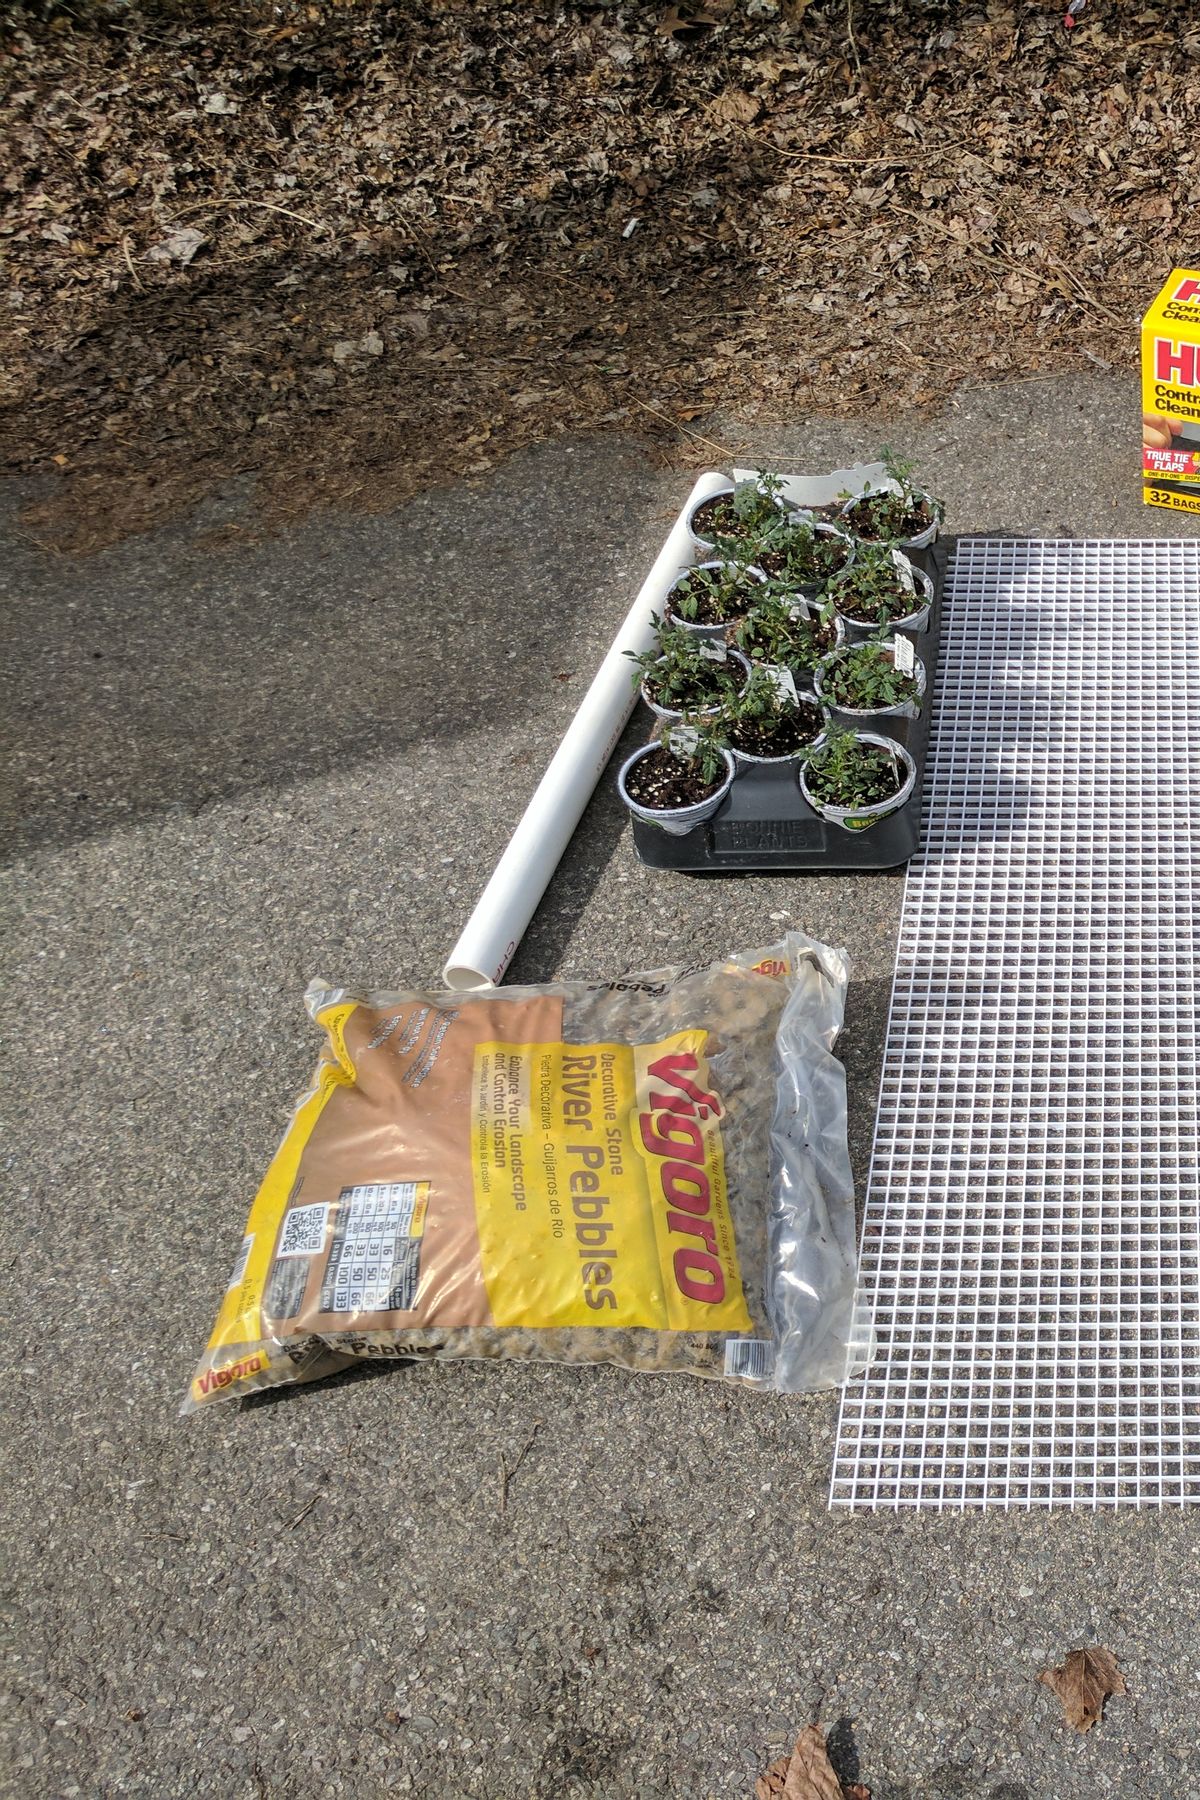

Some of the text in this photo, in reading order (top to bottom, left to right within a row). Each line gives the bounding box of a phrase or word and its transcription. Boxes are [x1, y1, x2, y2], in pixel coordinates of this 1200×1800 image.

[1146, 451, 1189, 463] TRUE TIE
[1154, 461, 1184, 472] FLAPS
[1150, 490, 1171, 505] 32
[494, 1052, 507, 1168] and Control Erosion
[600, 1052, 624, 1175] Decorative Stone
[479, 1119, 488, 1150] Controla
[508, 1055, 527, 1211] Enhance Your Landscape
[541, 1055, 564, 1239] Piedra Decorativa Guijarros de Río
[707, 1130, 720, 1176] Beautiful
[479, 1162, 491, 1193] Erosión
[562, 1055, 618, 1310] River Pebbles
[639, 1053, 725, 1304] Vigoro
[713, 1180, 725, 1220] Gardens
[719, 1224, 730, 1251] Since
[344, 1245, 354, 1257] 66
[356, 1244, 366, 1256] 33
[370, 1243, 379, 1256] 33
[383, 1244, 393, 1255] 16
[338, 1266, 349, 1284] 100
[353, 1268, 363, 1280] 50
[368, 1268, 377, 1280] 50
[336, 1291, 347, 1308] 133
[352, 1292, 361, 1306] 66
[197, 1358, 262, 1394] Vigoro
